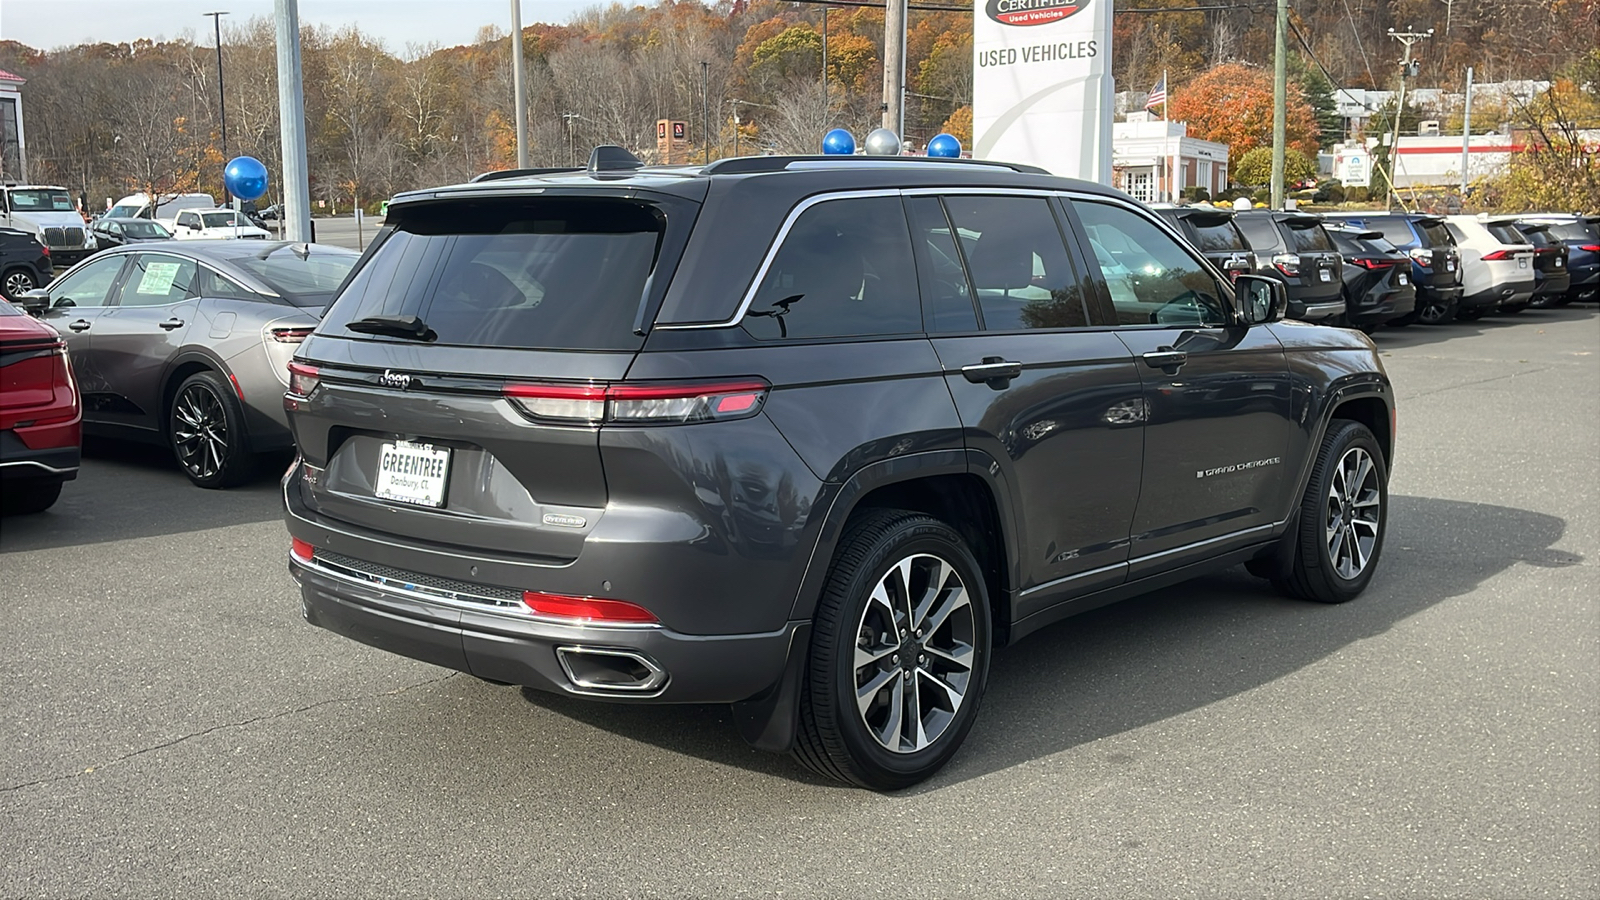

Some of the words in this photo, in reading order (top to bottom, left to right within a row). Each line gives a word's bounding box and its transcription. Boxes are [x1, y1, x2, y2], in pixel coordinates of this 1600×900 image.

[1009, 14, 1028, 22] Used
[1029, 11, 1064, 20] Vehicles
[979, 48, 1017, 67] USED
[1022, 40, 1098, 63] VEHICLES
[380, 369, 410, 391] Jeep
[383, 452, 444, 479] GREENTREE
[1205, 465, 1235, 477] GRAND
[1236, 457, 1280, 471] CHEROKEE
